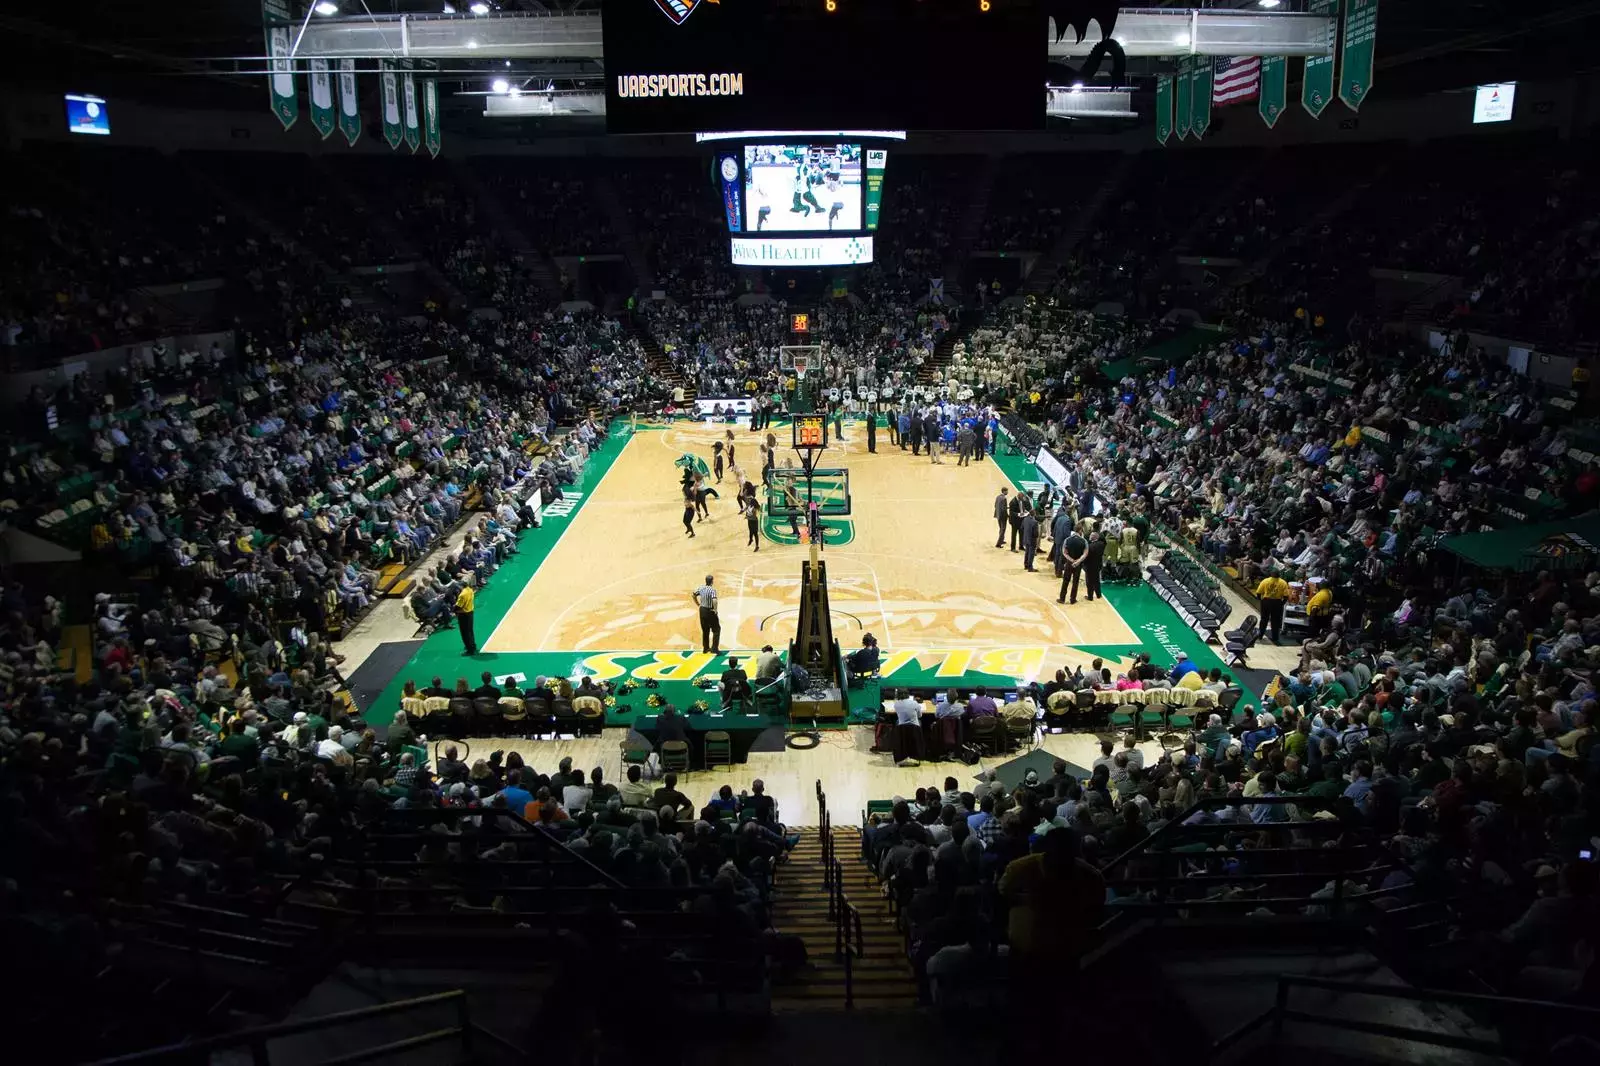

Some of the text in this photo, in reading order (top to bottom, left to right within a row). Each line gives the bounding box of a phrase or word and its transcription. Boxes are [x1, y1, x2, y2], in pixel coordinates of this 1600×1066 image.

[617, 73, 744, 98] UABSPORTS.COM
[761, 244, 821, 260] HEALTH
[569, 646, 1048, 682] BLAERS
